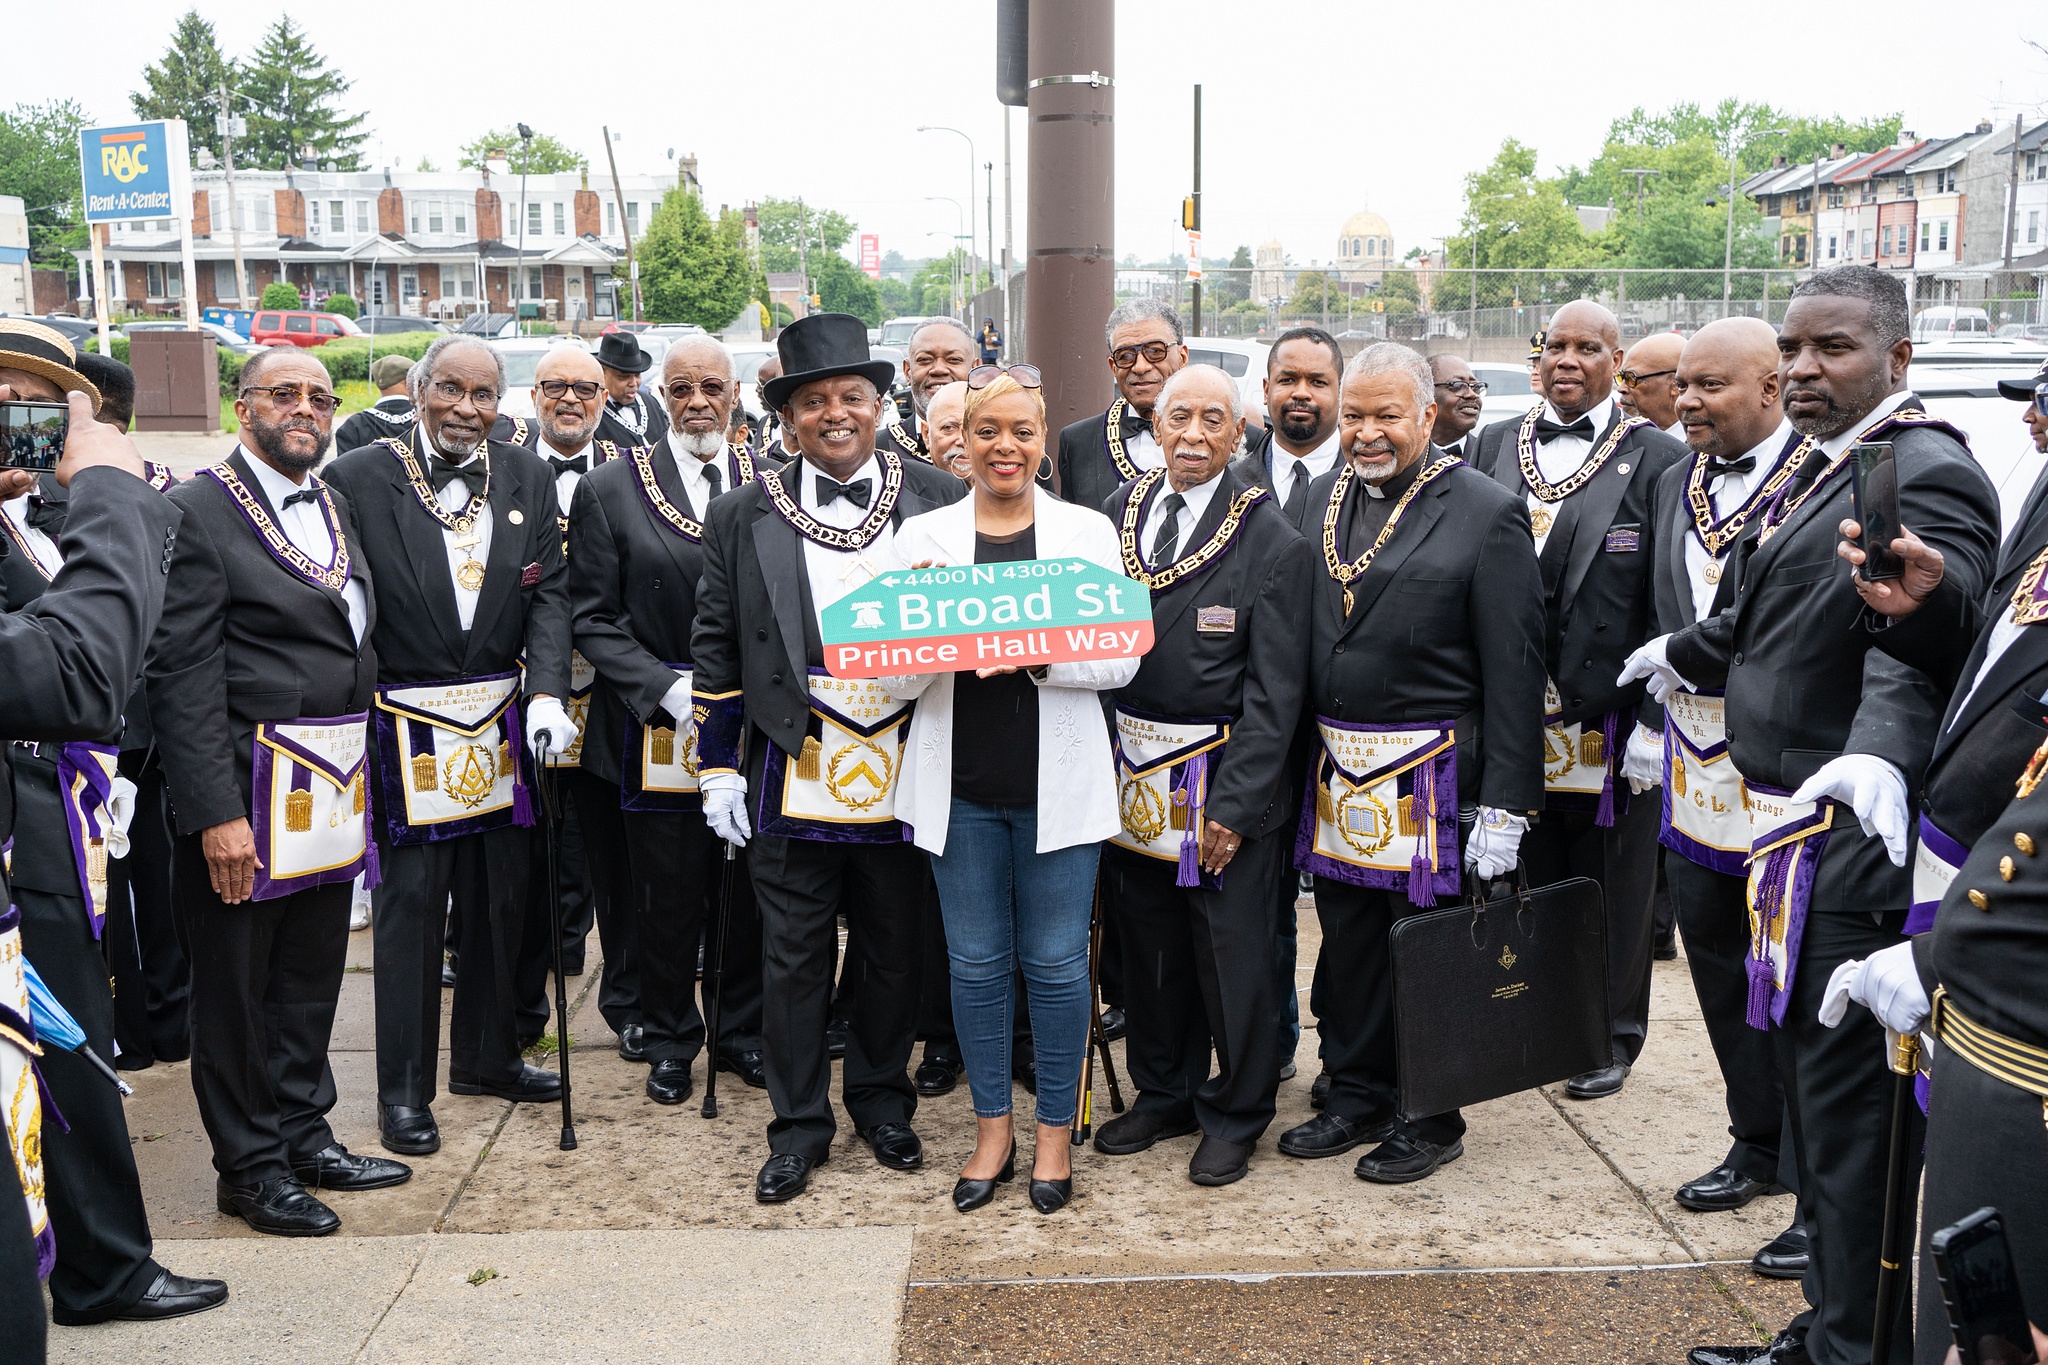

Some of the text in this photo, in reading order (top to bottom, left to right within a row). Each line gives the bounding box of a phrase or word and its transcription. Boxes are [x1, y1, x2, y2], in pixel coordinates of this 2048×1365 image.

[101, 143, 149, 183] RAC
[904, 562, 1063, 587] 4400 N 4300
[898, 582, 1125, 631] Broad St
[838, 628, 1140, 670] Prince Hall Way
[1350, 734, 1379, 745] Grand
[1381, 735, 1414, 746] Lodge
[1757, 799, 1784, 817] Lodge
